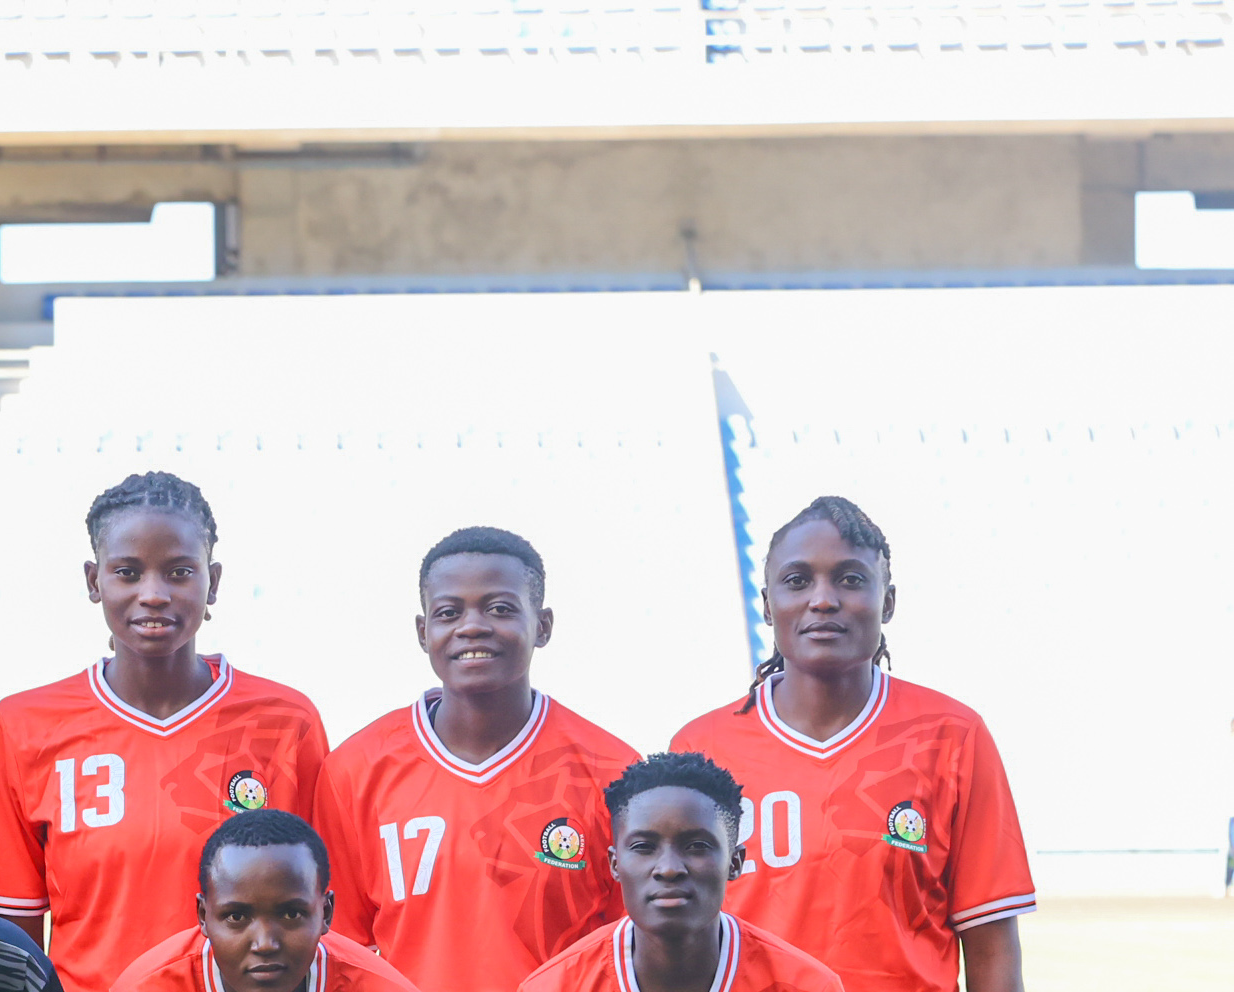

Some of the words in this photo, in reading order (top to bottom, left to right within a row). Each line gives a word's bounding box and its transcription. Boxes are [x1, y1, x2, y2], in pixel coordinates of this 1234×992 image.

[54, 753, 125, 833] 13
[379, 815, 446, 902] 17
[543, 857, 579, 869] FEDERATION
